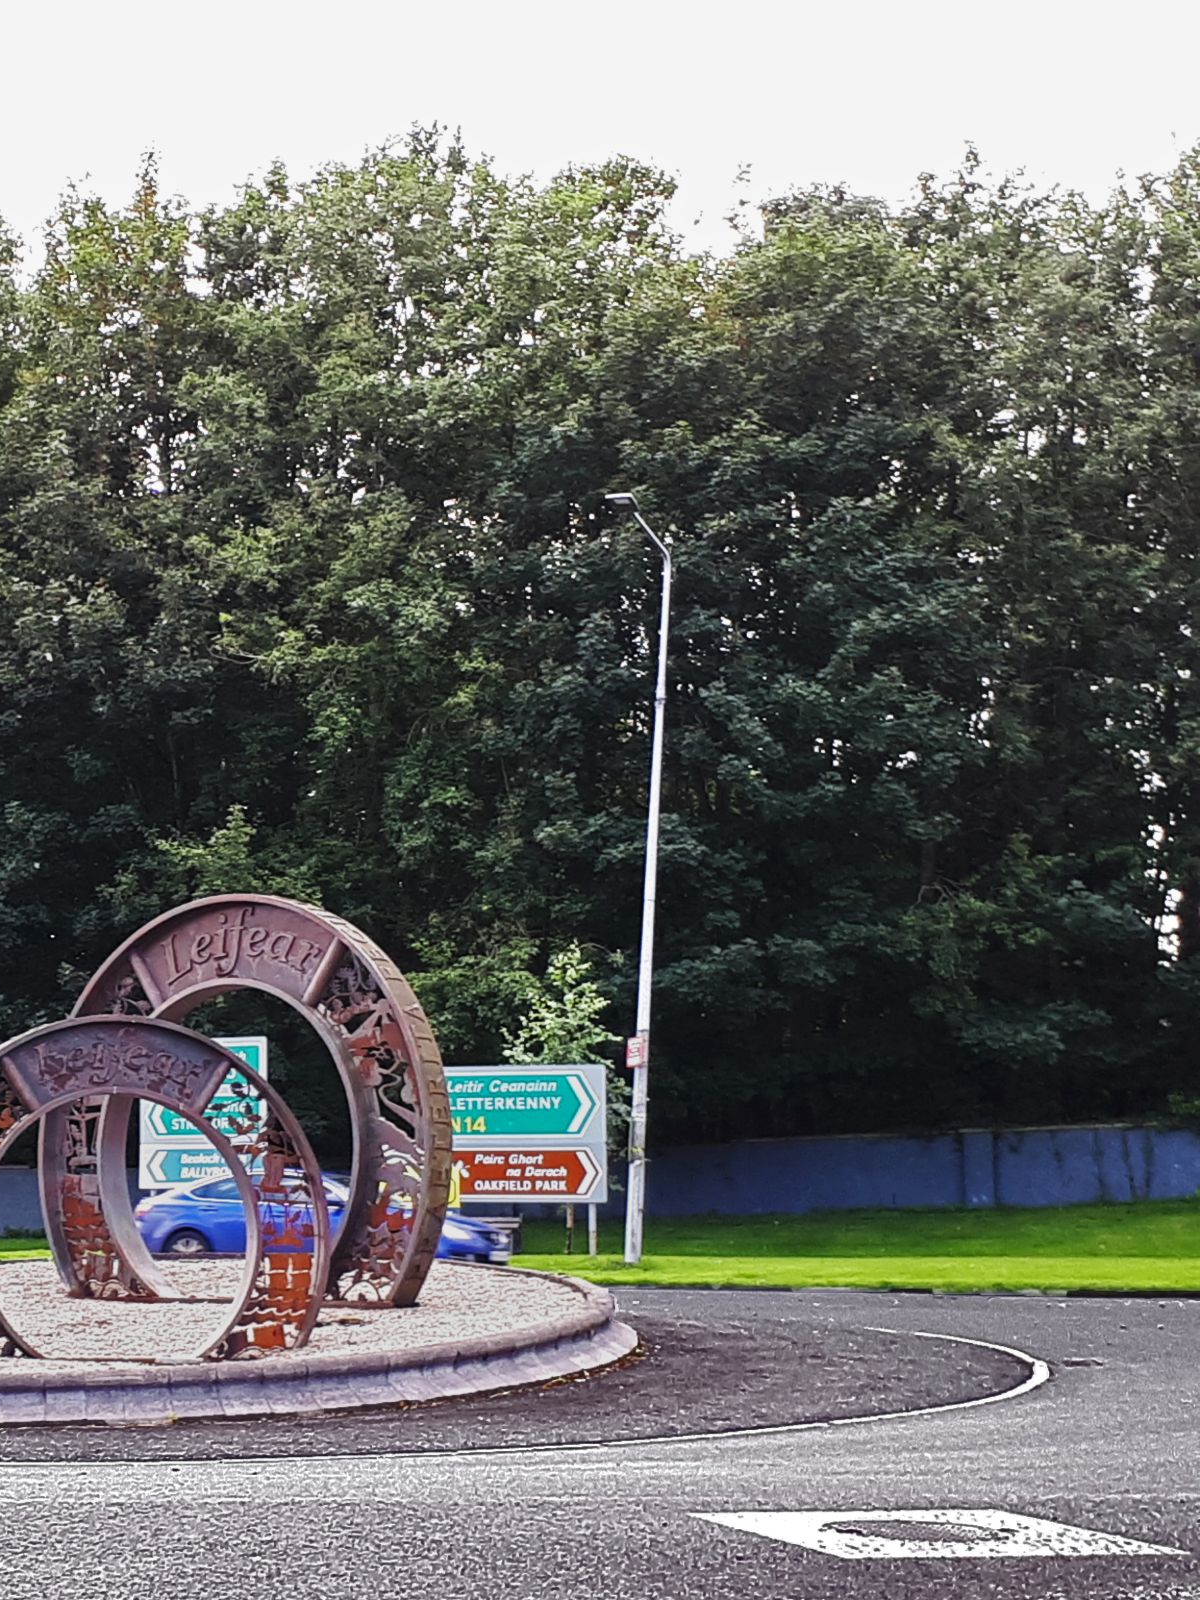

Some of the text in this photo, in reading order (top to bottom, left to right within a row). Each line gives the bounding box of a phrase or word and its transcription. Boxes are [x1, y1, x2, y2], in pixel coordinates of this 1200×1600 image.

[160, 906, 323, 986] Leifear
[447, 1079, 558, 1093] Leitir Ceanainn
[449, 1096, 562, 1111] LETTERKENNY
[451, 1115, 487, 1133] N14
[474, 1180, 568, 1191] OAKFIELD PARK
